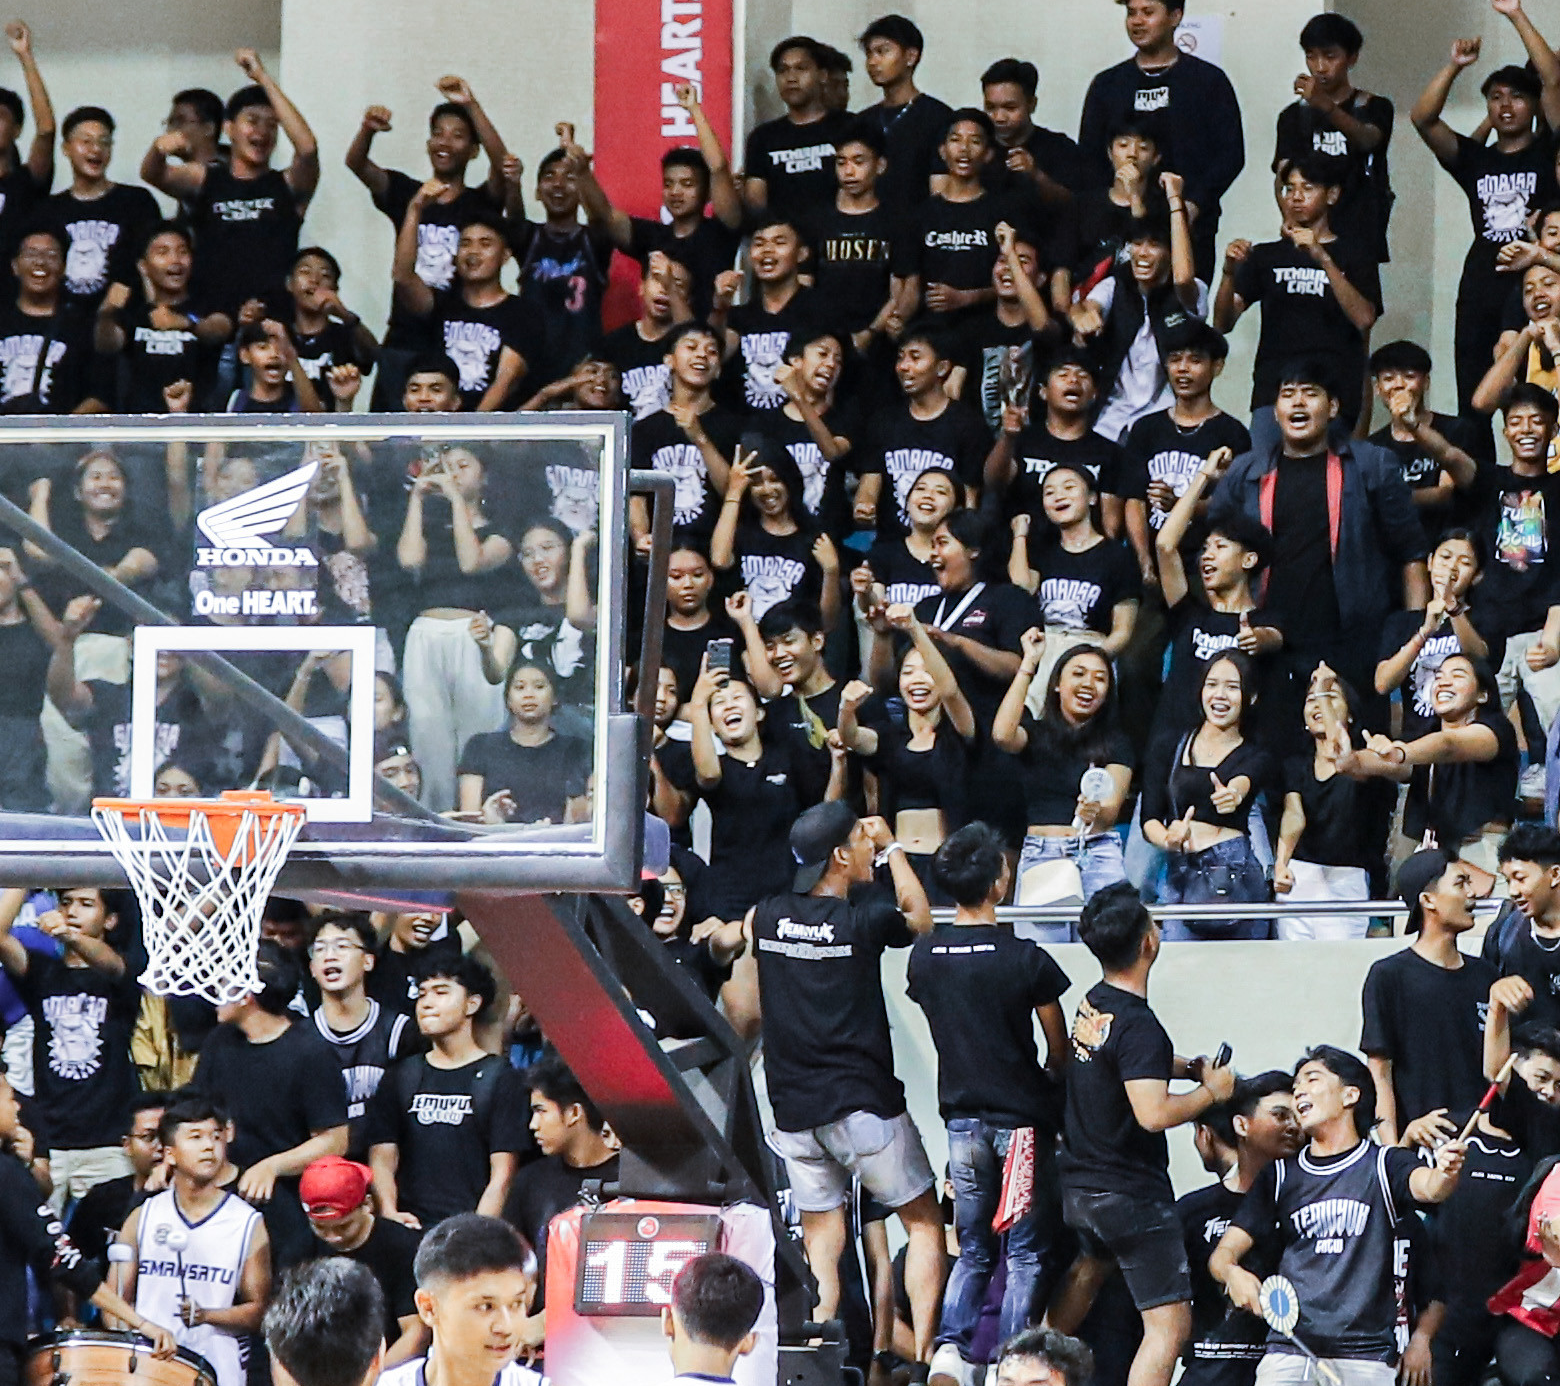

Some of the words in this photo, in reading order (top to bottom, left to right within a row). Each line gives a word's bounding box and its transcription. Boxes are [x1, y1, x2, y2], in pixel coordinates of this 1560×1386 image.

[563, 276, 585, 311] 3
[196, 547, 318, 567] HONDA
[195, 590, 239, 615] One
[242, 590, 317, 615] HEART.
[140, 1260, 234, 1284] SMANSATU
